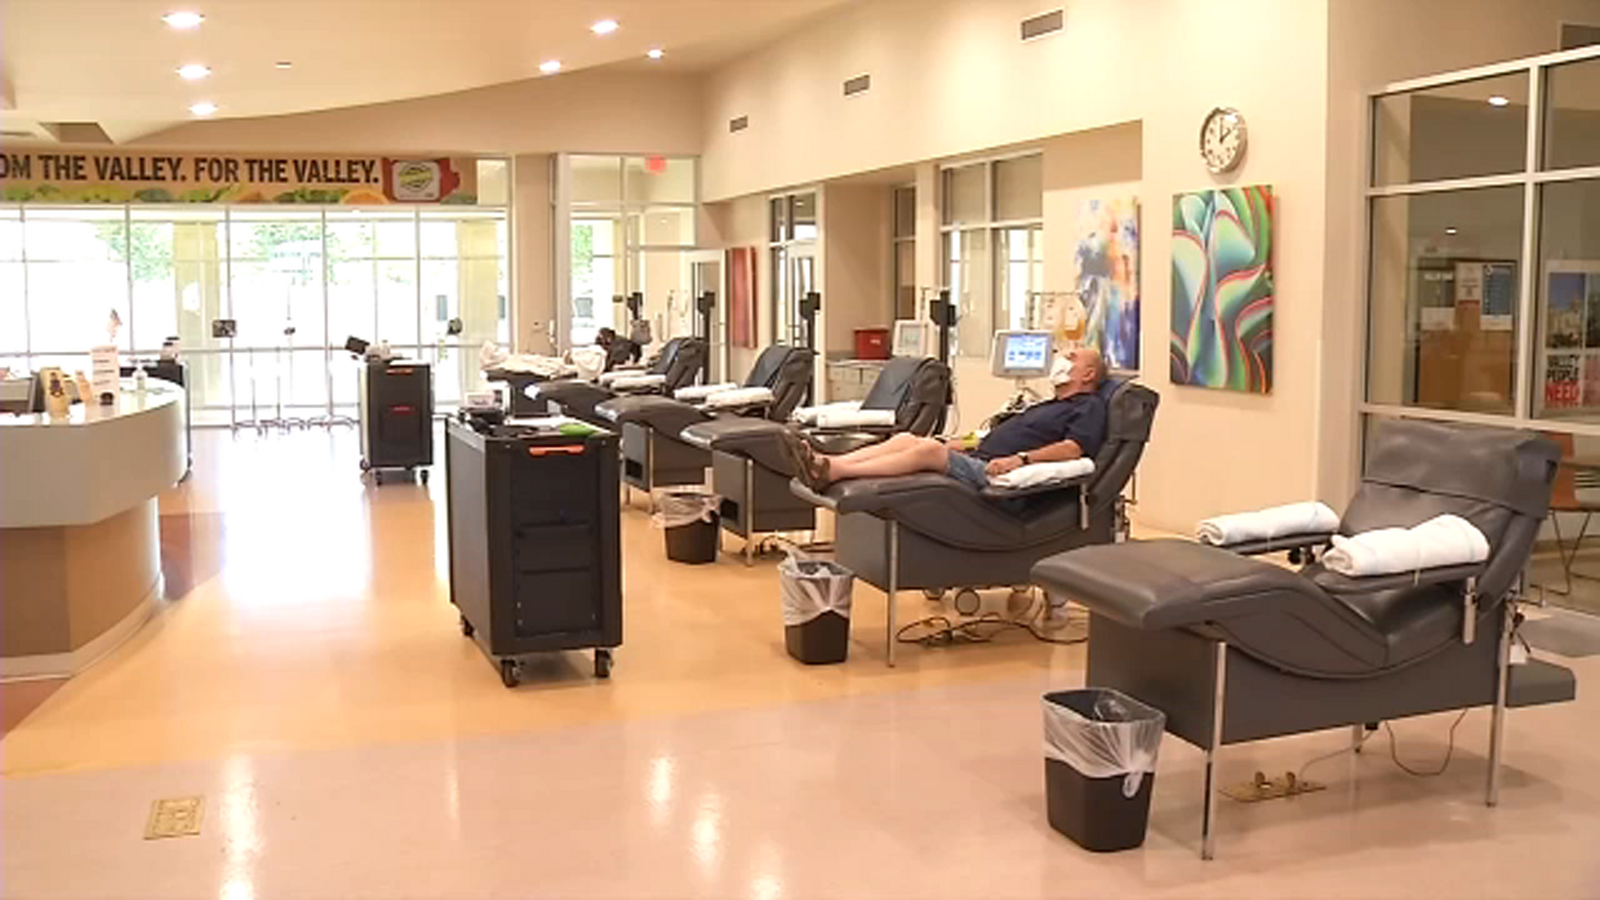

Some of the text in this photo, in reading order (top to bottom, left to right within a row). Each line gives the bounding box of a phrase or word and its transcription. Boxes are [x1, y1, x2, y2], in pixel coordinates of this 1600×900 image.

[37, 154, 87, 180] THE
[93, 156, 187, 182] VALLEY.
[194, 156, 239, 182] FOR
[244, 158, 289, 183] THE
[293, 159, 379, 183] VALLEY.
[1545, 384, 1580, 401] NEED
